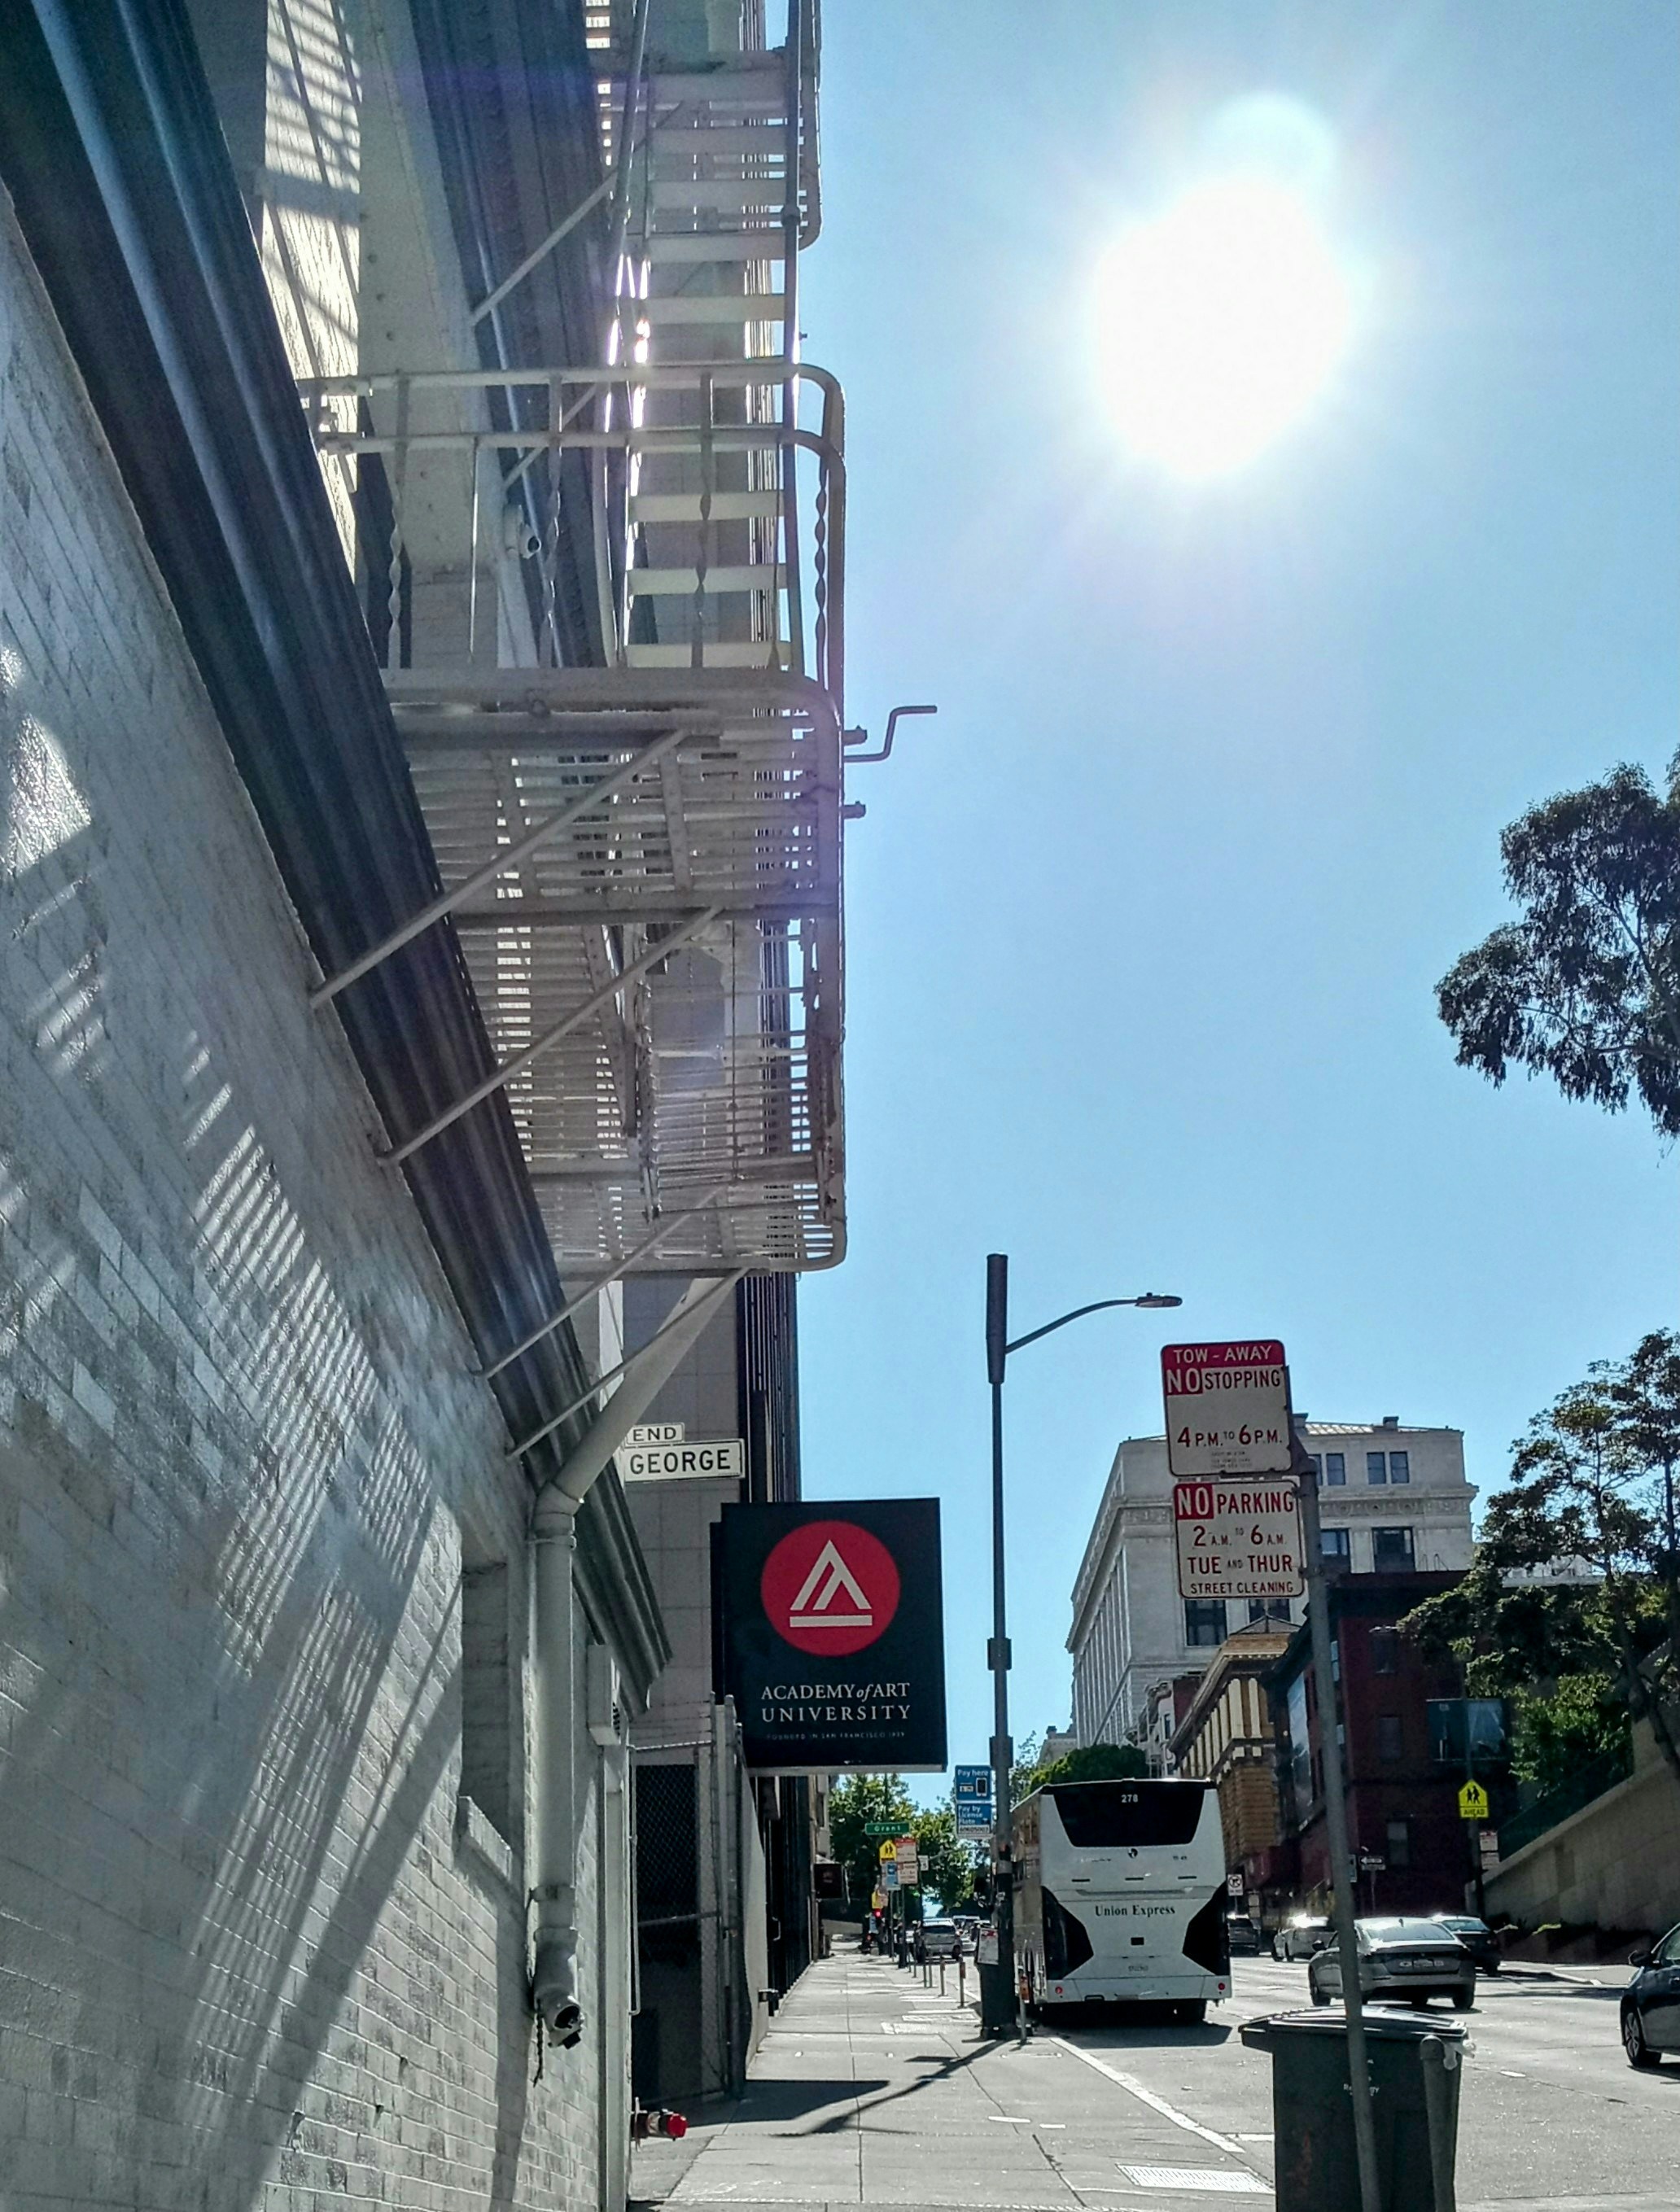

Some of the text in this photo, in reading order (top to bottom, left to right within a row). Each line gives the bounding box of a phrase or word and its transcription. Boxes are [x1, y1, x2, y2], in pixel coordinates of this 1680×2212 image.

[1166, 1367, 1280, 1393] NO STOPPING
[633, 1427, 676, 1441] END
[1177, 1427, 1191, 1448] 4
[1239, 1423, 1251, 1445] 6
[629, 1449, 731, 1475] GEORGE
[1178, 1486, 1294, 1516] NO PARKING
[1193, 1525, 1206, 1546] 2
[1251, 1524, 1263, 1545] 6
[1188, 1554, 1293, 1575] TUE AND THUR
[1191, 1581, 1293, 1594] STREET CLEANING
[761, 1682, 910, 1703] ACADEMY of ART
[762, 1705, 910, 1723] UNIVERSITY
[957, 1768, 971, 1778] Pay
[1121, 1794, 1139, 1803] 278
[1095, 1904, 1176, 1918] Union Express
